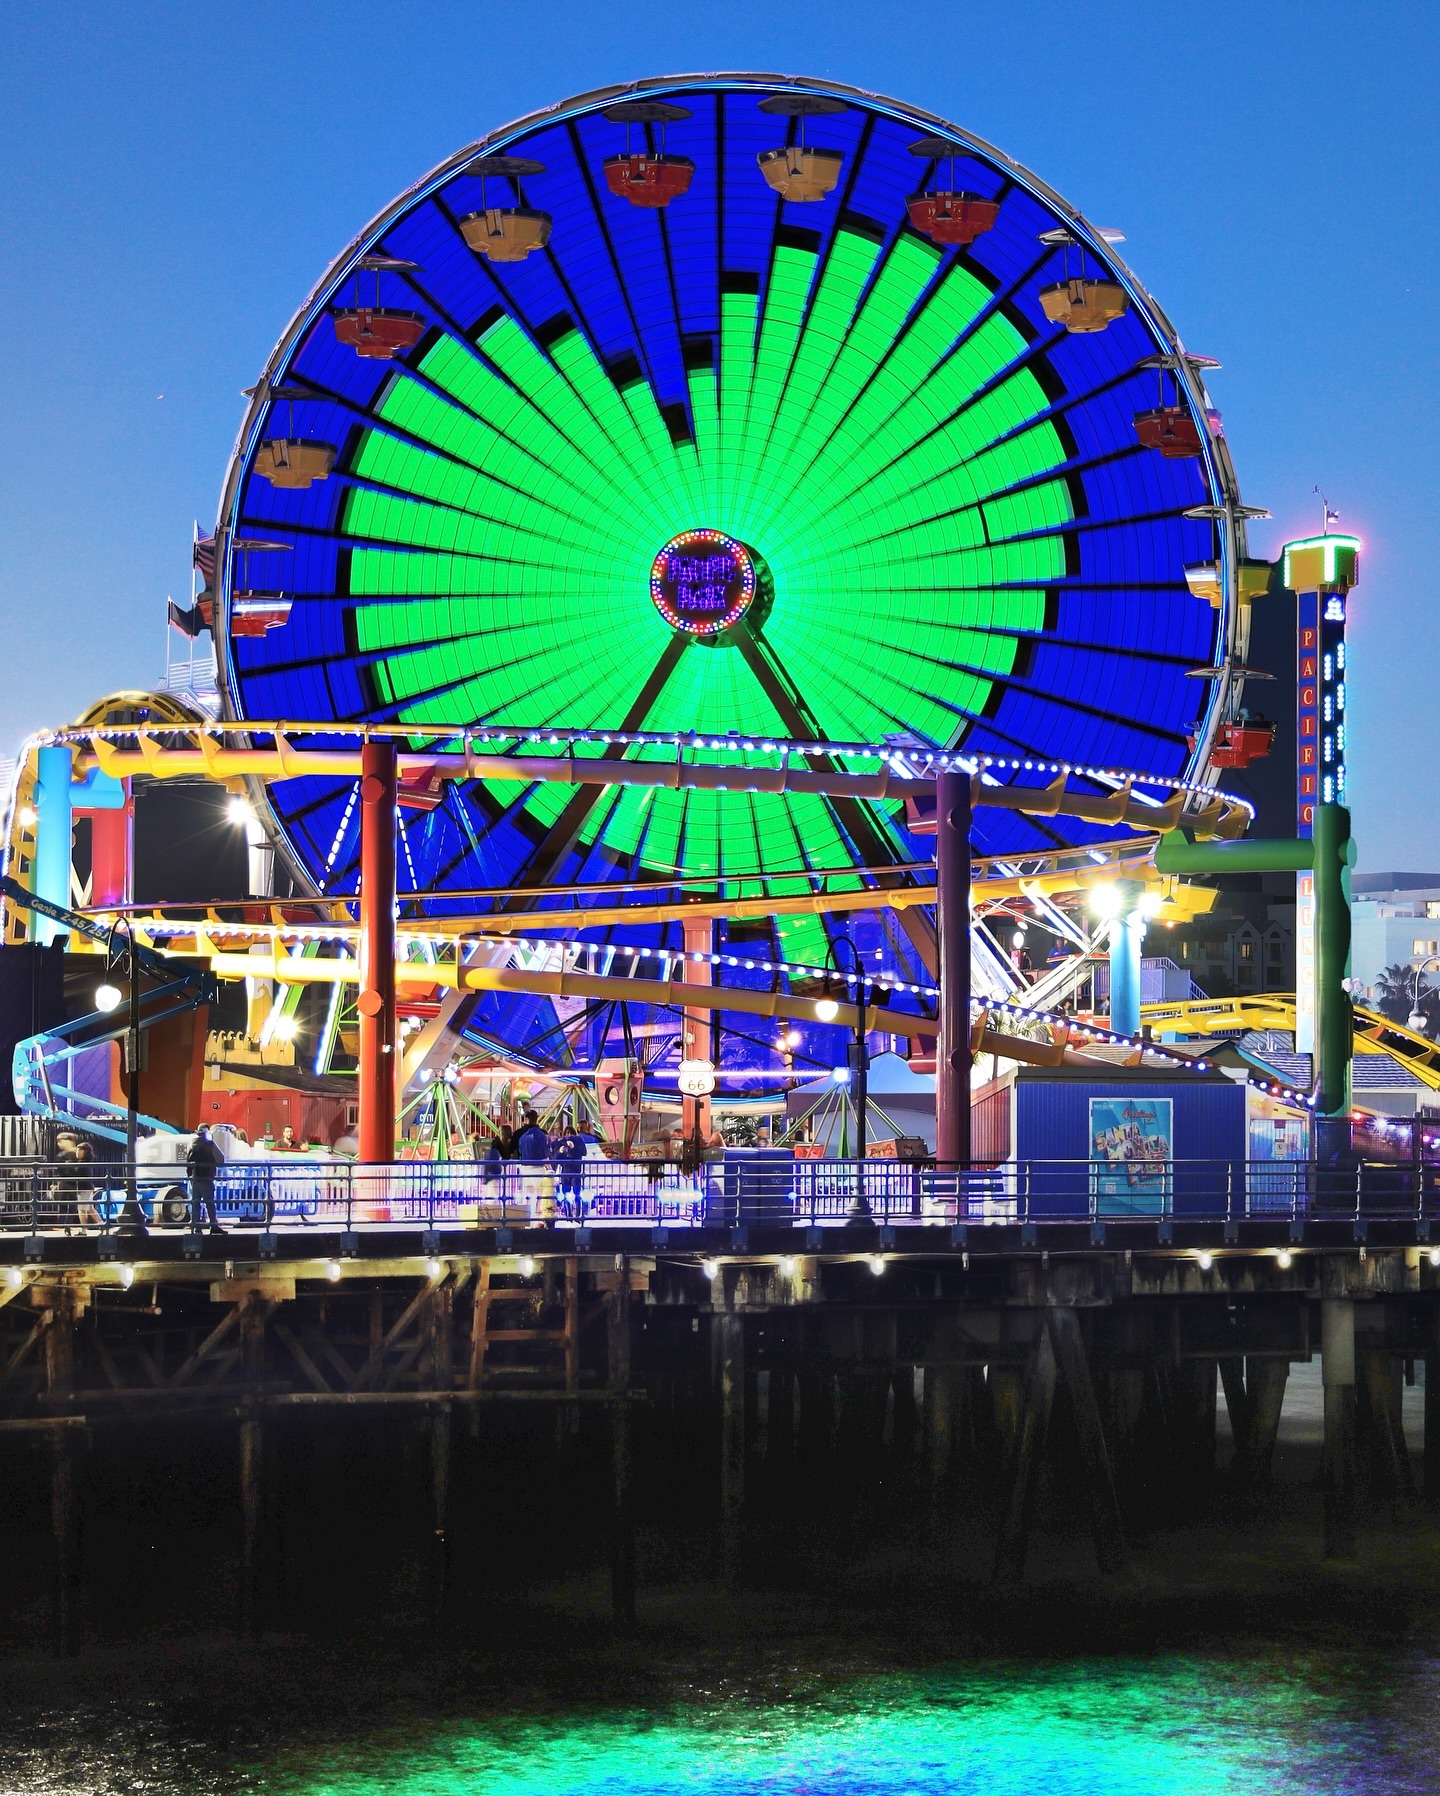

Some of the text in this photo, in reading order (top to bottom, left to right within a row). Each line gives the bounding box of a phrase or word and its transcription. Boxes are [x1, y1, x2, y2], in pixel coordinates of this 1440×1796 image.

[667, 556, 736, 582] PACIFIC
[678, 584, 725, 610] PARK
[1303, 631, 1313, 822] PACIFIC
[31, 899, 110, 940] Genie Z-45/25J
[688, 1079, 705, 1091] 66
[1095, 1122, 1142, 1152] SANTA
